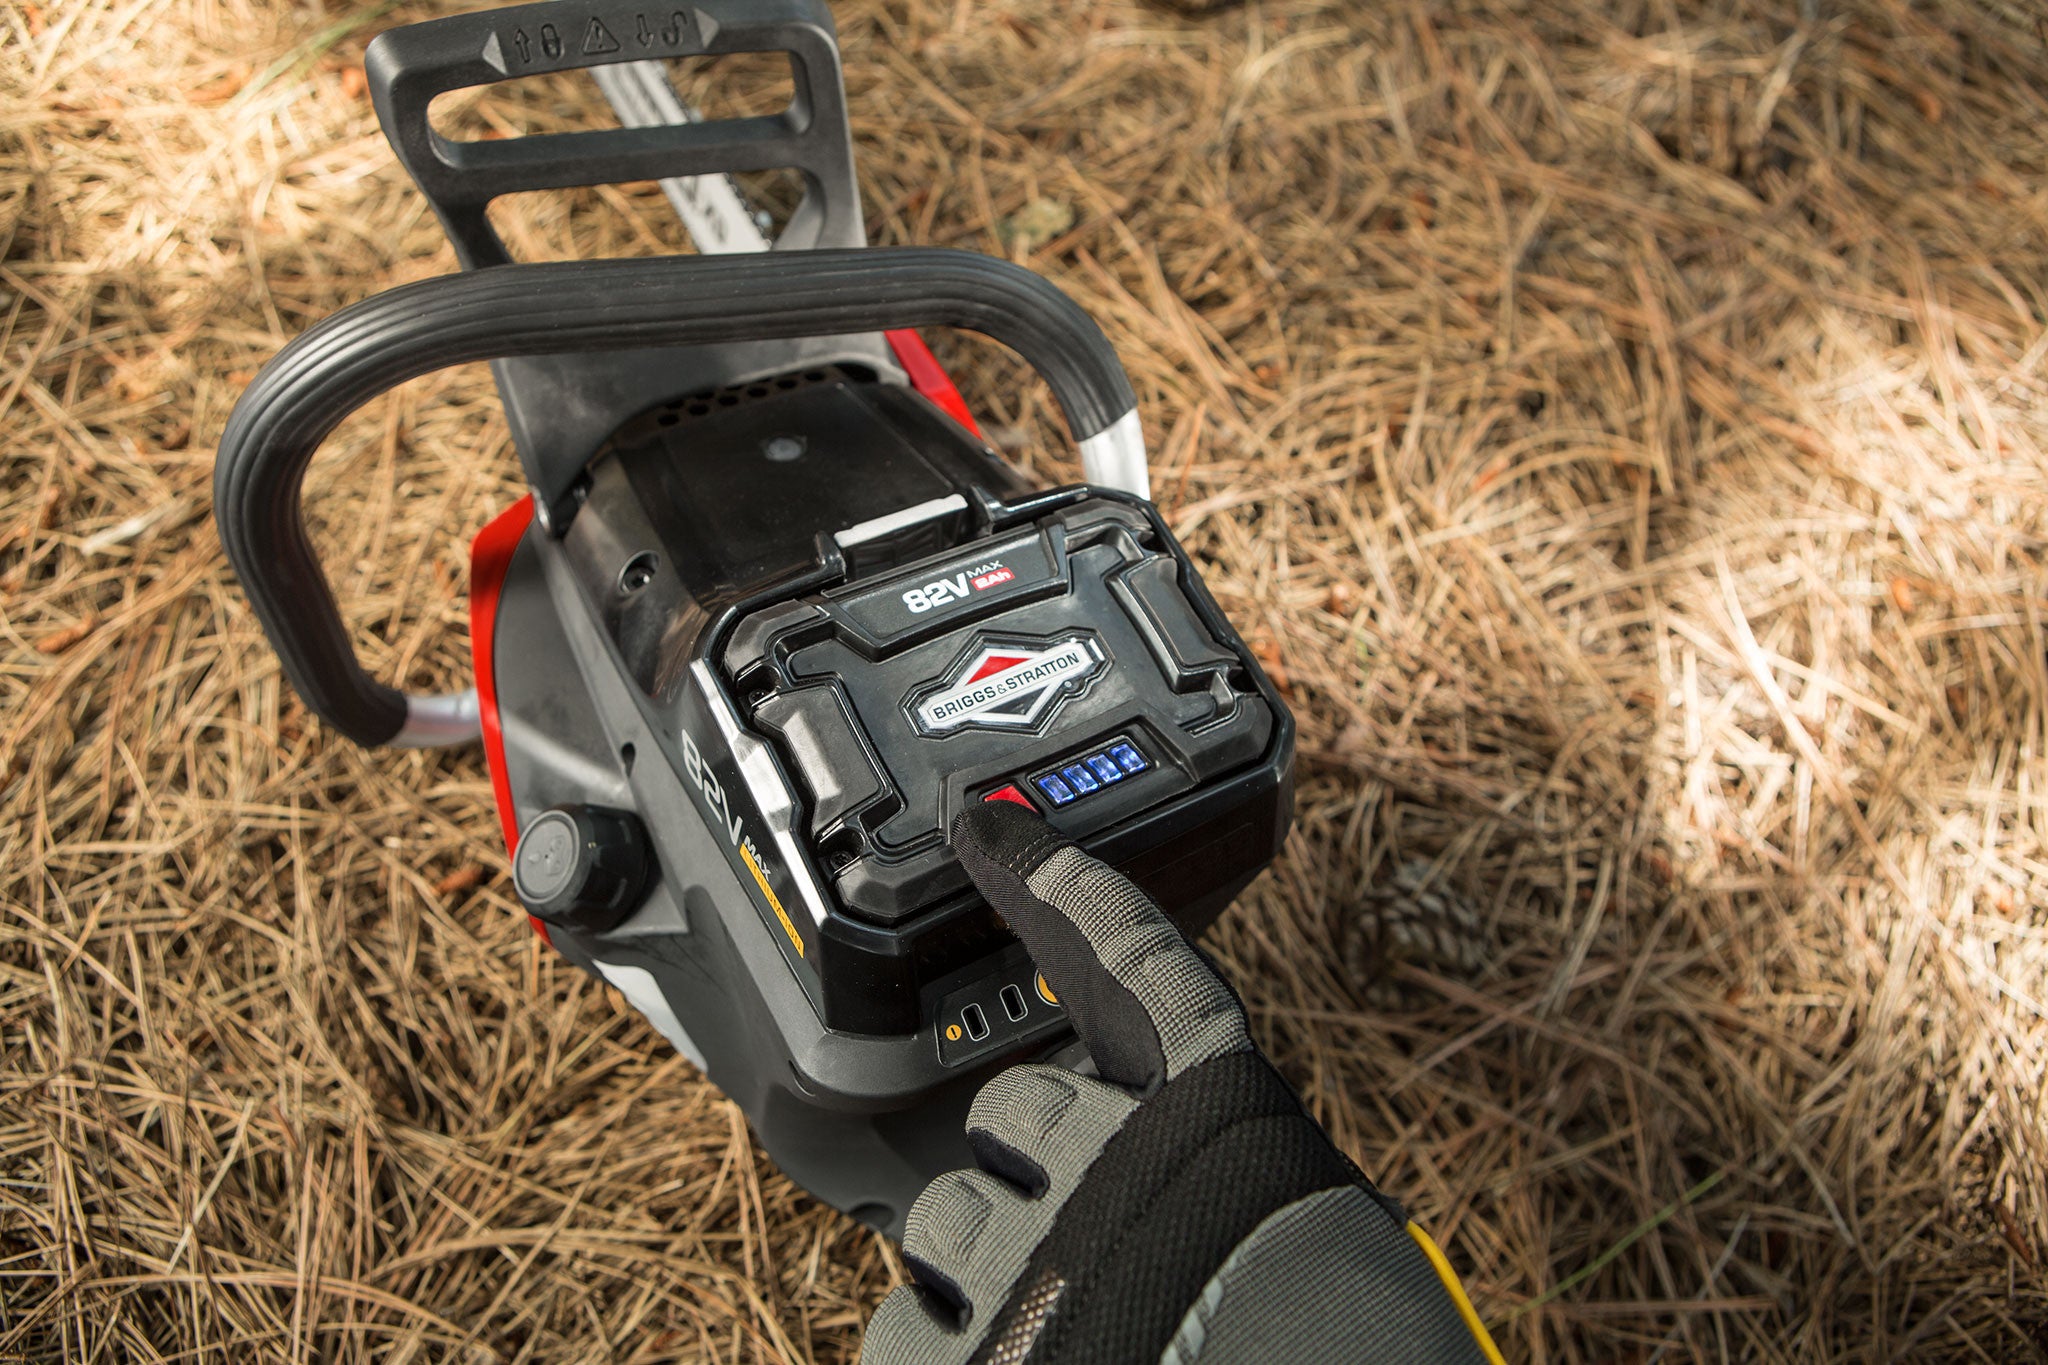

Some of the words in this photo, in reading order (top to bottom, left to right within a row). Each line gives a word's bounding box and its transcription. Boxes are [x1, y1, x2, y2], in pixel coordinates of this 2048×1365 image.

[902, 572, 970, 613] 82V
[966, 560, 1003, 578] MAX
[682, 729, 743, 846] 82V
[744, 835, 771, 882] MAX
